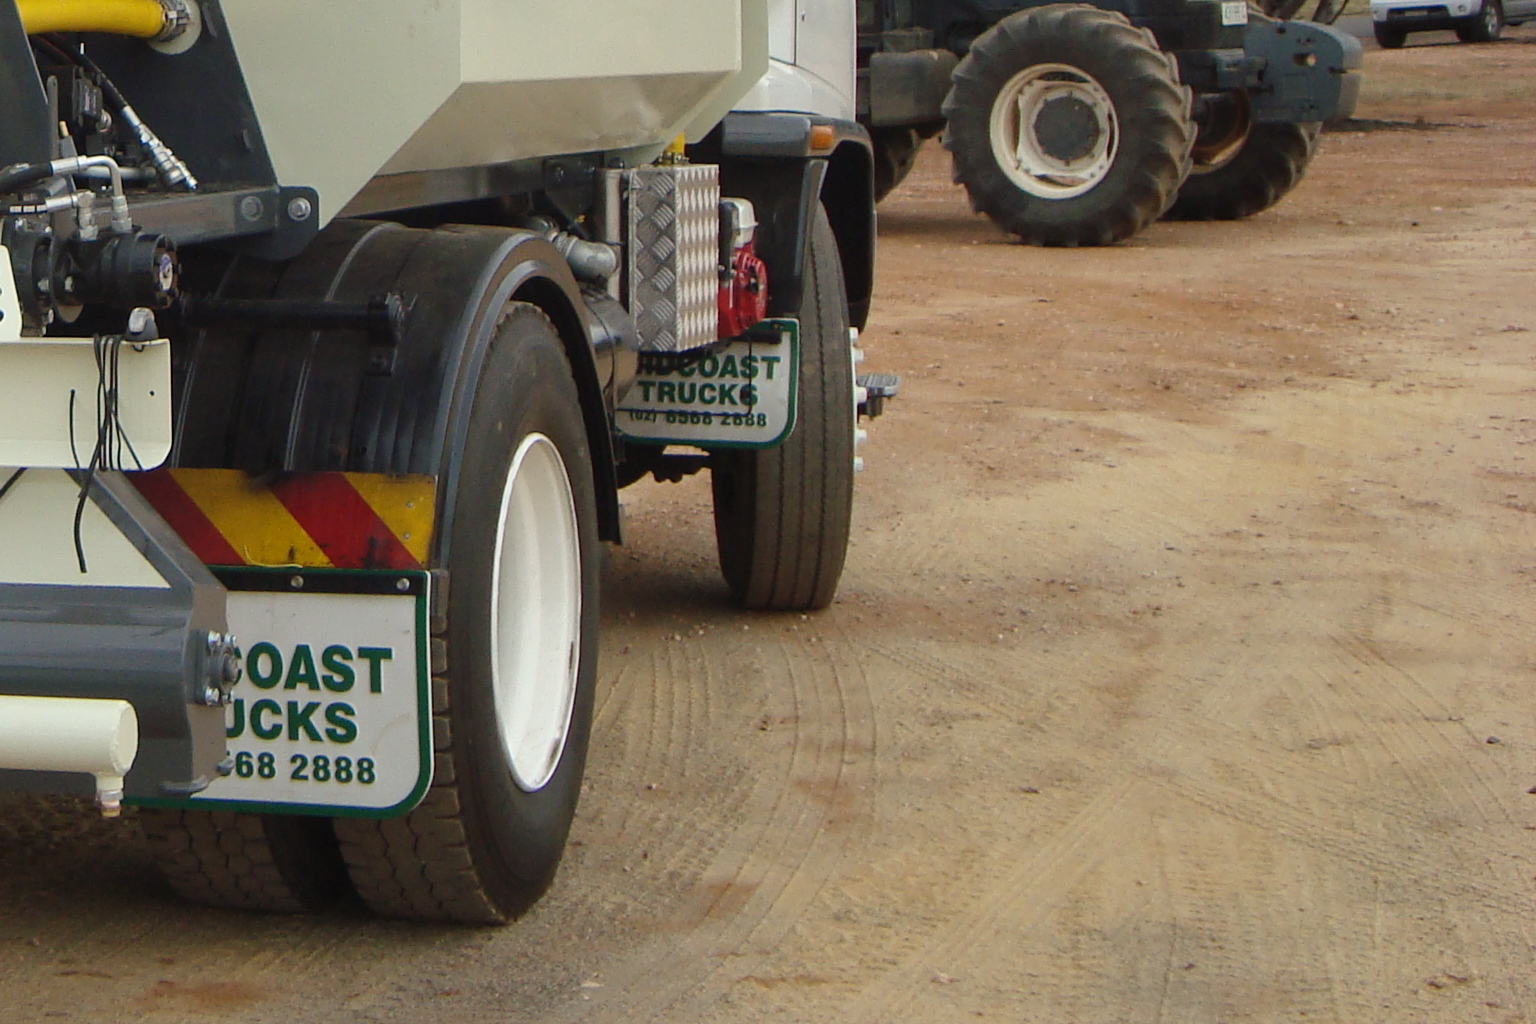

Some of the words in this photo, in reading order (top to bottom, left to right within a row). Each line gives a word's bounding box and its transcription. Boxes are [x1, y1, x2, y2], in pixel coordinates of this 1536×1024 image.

[637, 380, 758, 406] TRUCKS
[232, 641, 394, 694] OAST
[226, 751, 277, 779] 68
[290, 753, 376, 785] 2888
